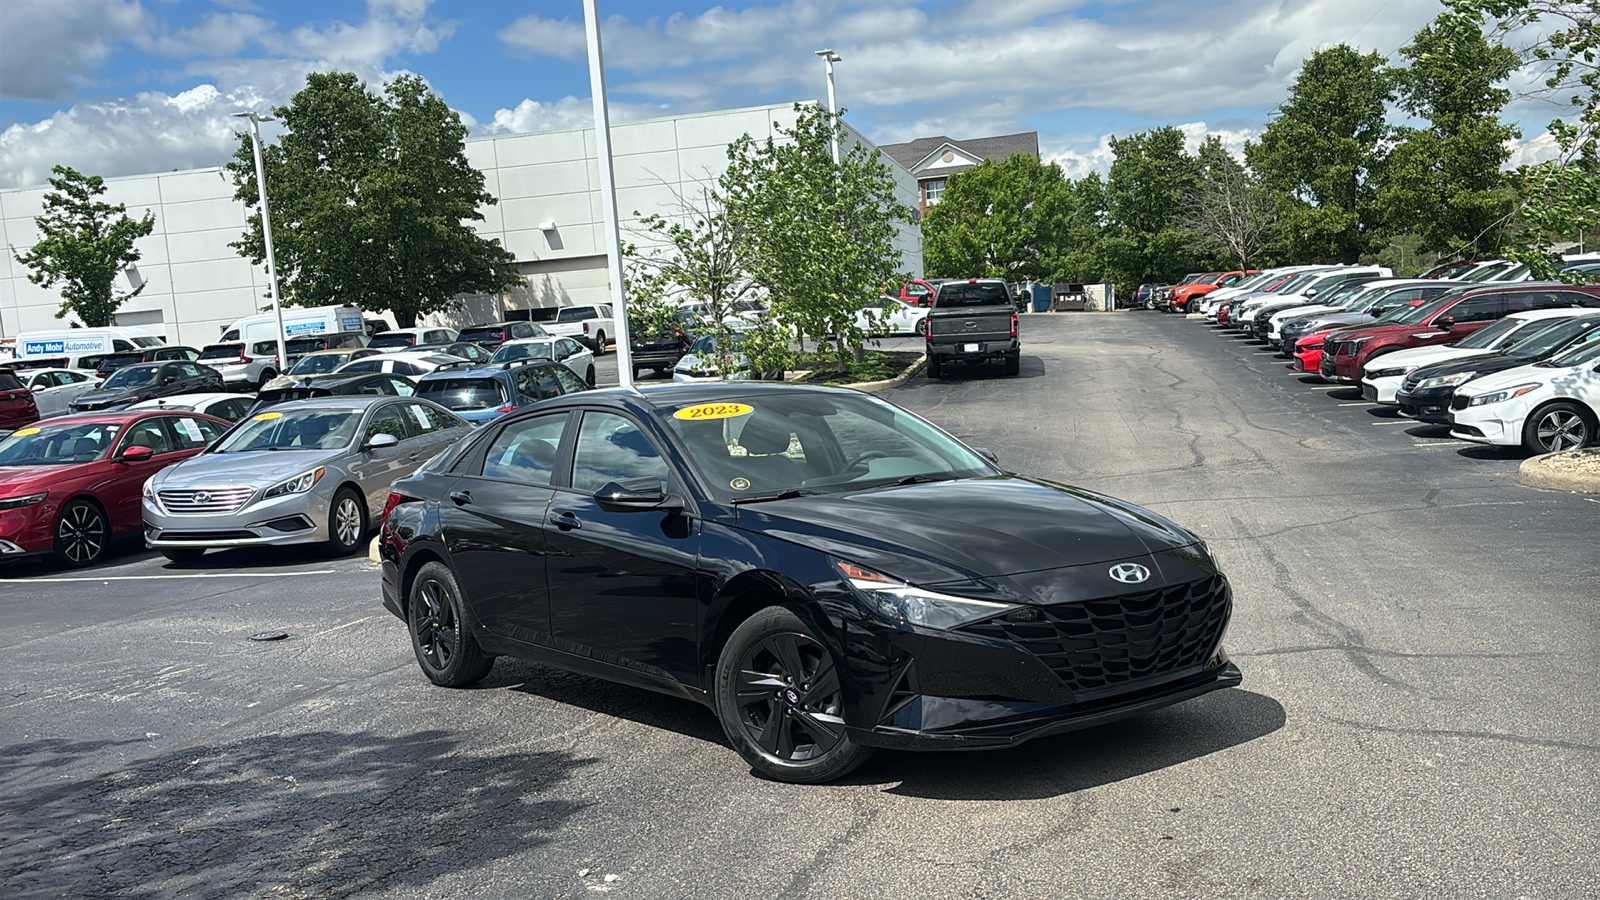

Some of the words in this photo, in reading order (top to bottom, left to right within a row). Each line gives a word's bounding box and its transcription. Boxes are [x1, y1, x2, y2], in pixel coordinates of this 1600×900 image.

[27, 344, 44, 354] Andy
[45, 343, 63, 351] Mohr
[64, 342, 102, 351] Automotive
[690, 405, 739, 418] 2023
